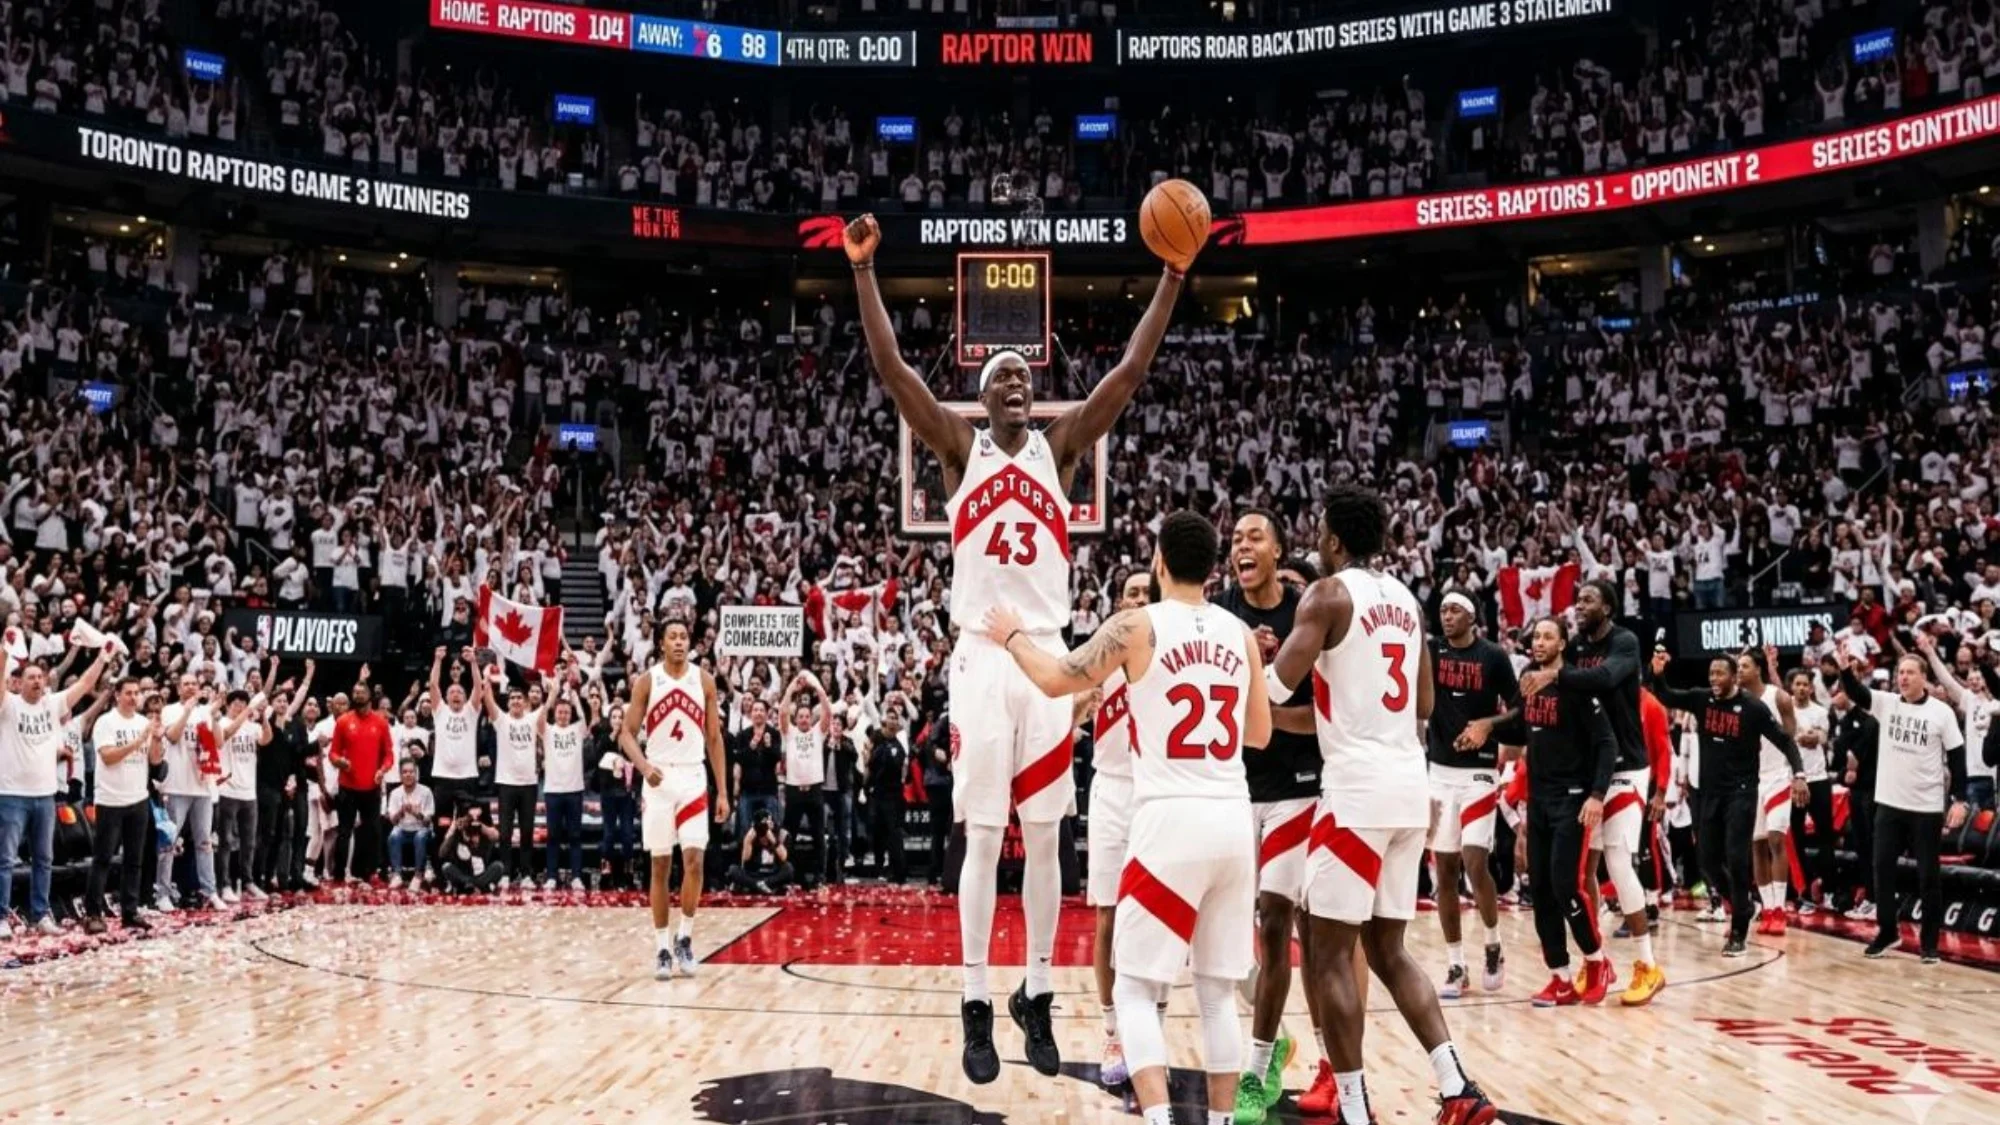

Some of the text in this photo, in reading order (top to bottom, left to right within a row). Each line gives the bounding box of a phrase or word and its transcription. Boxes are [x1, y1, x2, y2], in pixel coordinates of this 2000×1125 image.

[440, 0, 624, 43] HOME: RAPTORS 104
[638, 22, 683, 49] AWAY:
[741, 33, 766, 59] 98
[1128, 35, 1202, 60] RAPTORS
[1206, 35, 1248, 59] ROAR
[1252, 30, 1294, 58] BACK
[1296, 25, 1336, 53] INTO
[1339, 17, 1397, 48] SERIES
[1400, 10, 1444, 39] WITH
[1448, 4, 1496, 33] GAME
[1500, 1, 1511, 26] 3
[786, 36, 902, 62] 4TH QTR: 0:00
[942, 33, 1093, 64] RAPTOR WIN
[1812, 96, 2000, 168] SERIES CONTINU
[78, 126, 471, 219] TORONTO RAPTORS GAME 3 WINNERS
[1416, 193, 1493, 226] SERIES:
[1498, 182, 1590, 217] RAPTORS
[1594, 180, 1607, 207] 1
[1631, 156, 1740, 200] OPPONENT
[1746, 152, 1760, 182] 2
[921, 218, 1126, 244] RAPTORS WIN GAME 3
[986, 263, 1035, 289] 0:00
[968, 473, 1055, 520] RAPTORS
[984, 522, 1038, 566] 43
[271, 616, 358, 654] PLAYOFFS
[1747, 617, 1759, 648] 3
[1160, 640, 1243, 676] VANVLEET
[1381, 643, 1409, 713] 3
[670, 720, 684, 741] 4
[1166, 682, 1239, 761] 23
